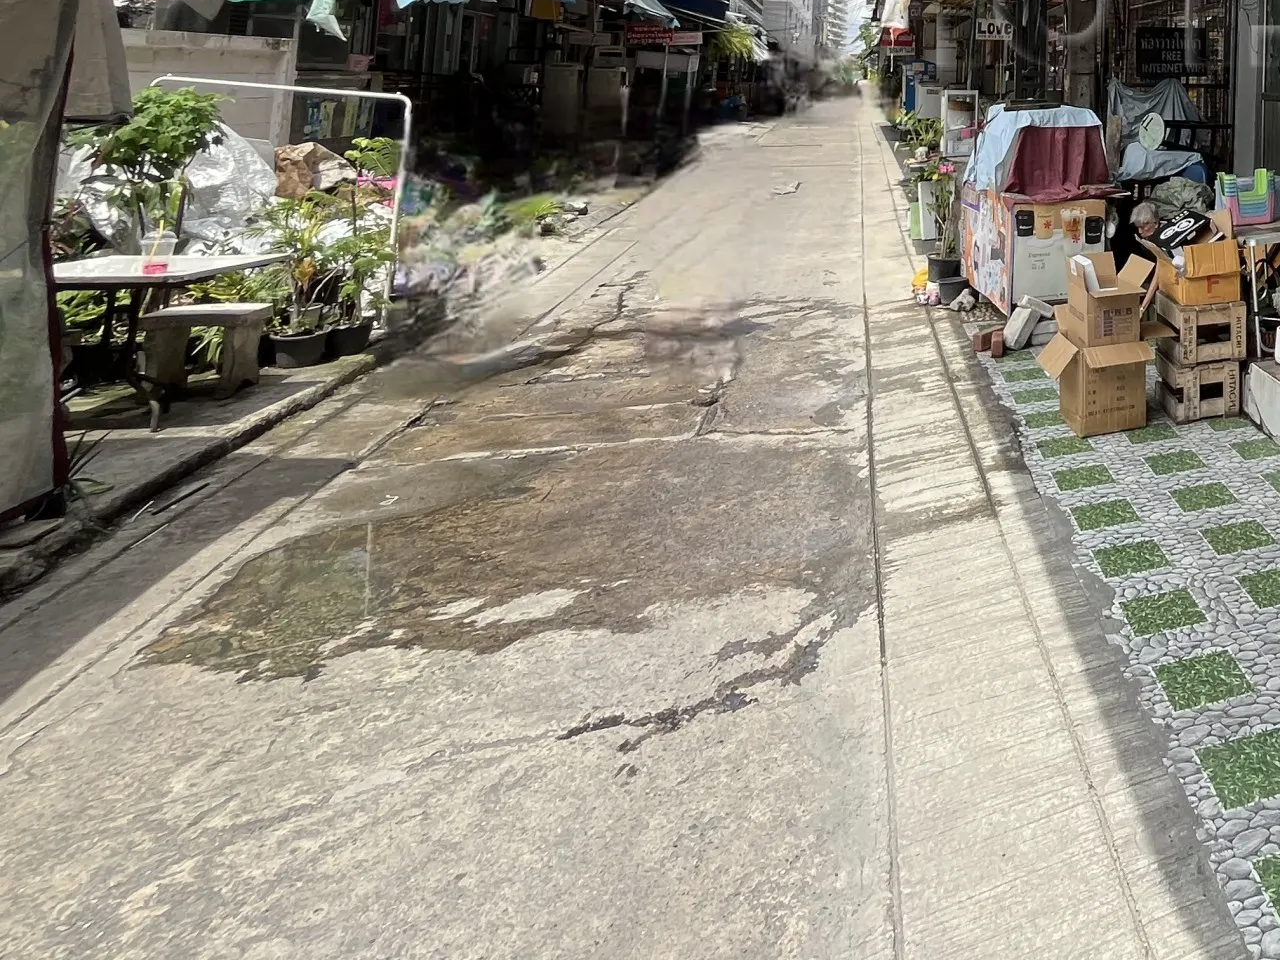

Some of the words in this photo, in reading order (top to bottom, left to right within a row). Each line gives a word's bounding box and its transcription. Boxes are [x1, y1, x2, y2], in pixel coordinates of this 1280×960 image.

[1161, 50, 1182, 61] FREE
[1141, 62, 1183, 73] INTERNET
[1235, 316, 1243, 349] HITACHI
[1227, 369, 1237, 411] HITACHI
